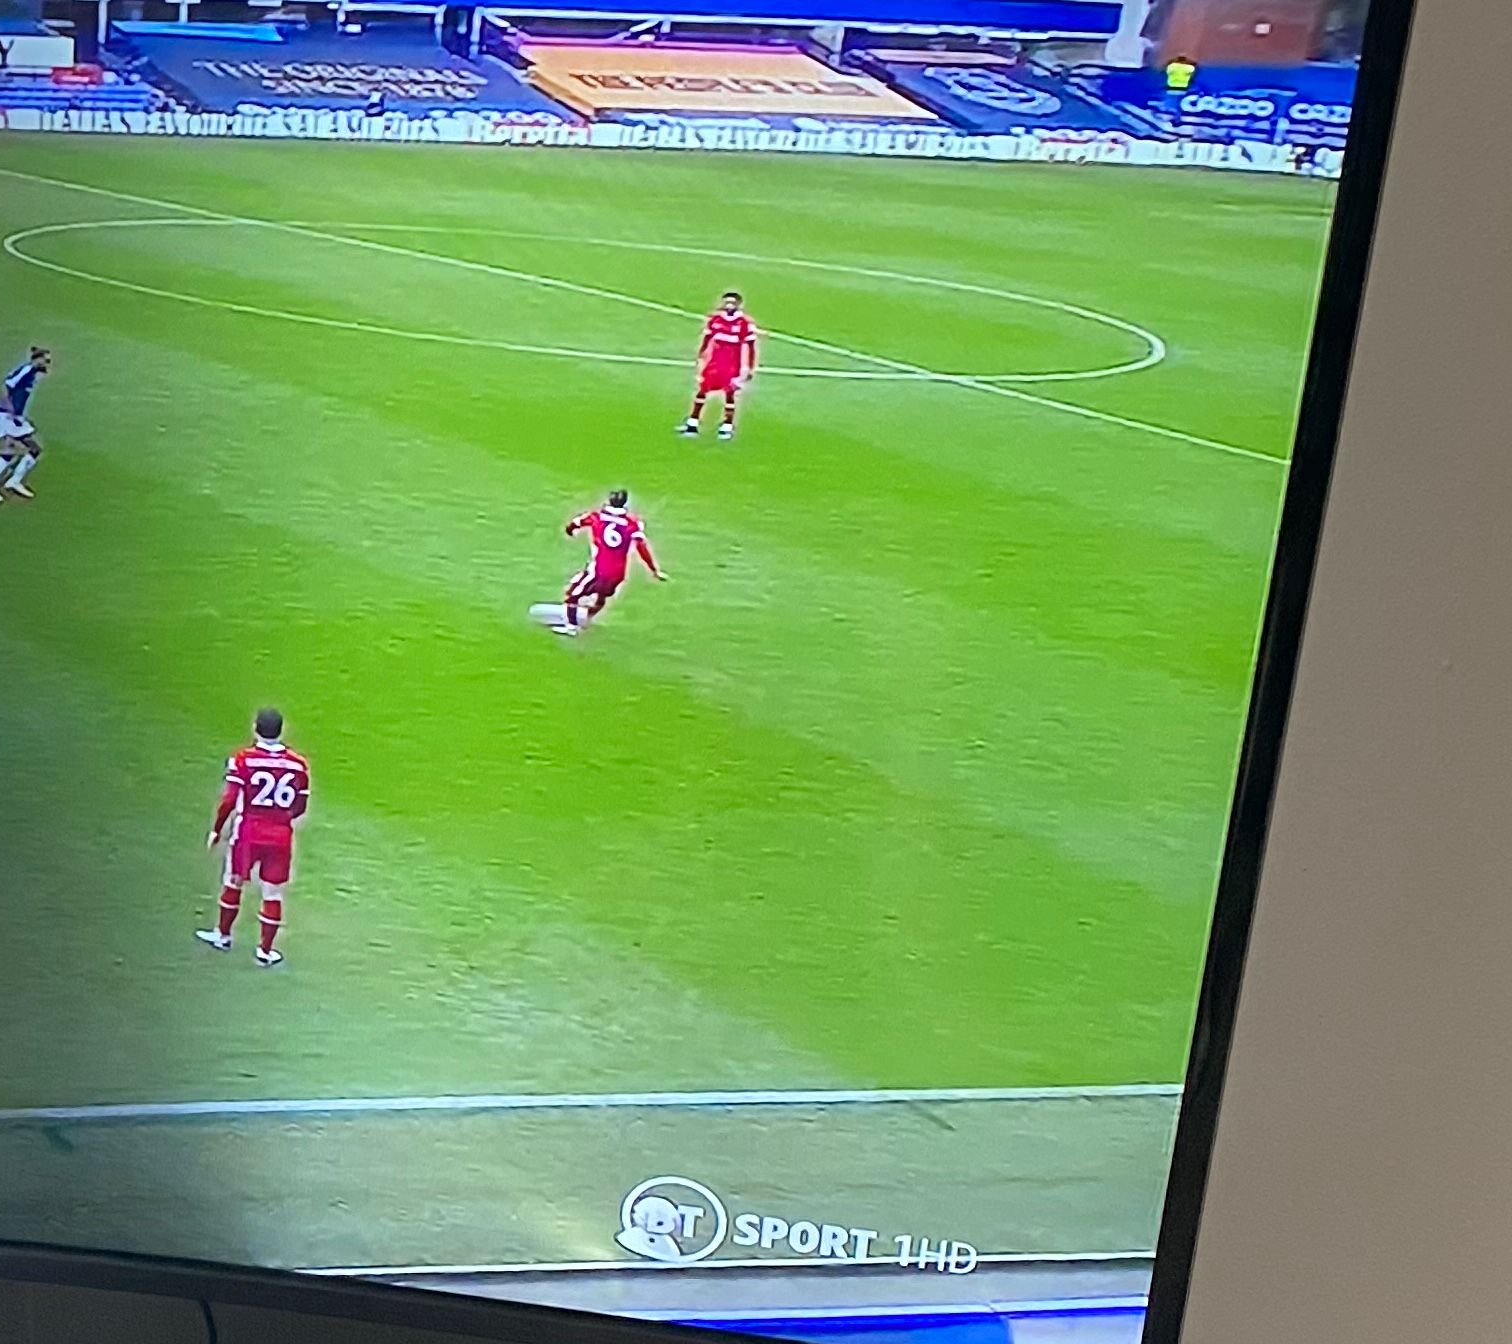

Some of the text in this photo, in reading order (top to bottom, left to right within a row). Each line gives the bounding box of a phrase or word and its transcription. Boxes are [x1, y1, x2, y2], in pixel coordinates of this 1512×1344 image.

[603, 522, 623, 548] 6
[250, 770, 296, 808] 26
[732, 1212, 879, 1260] SPORT
